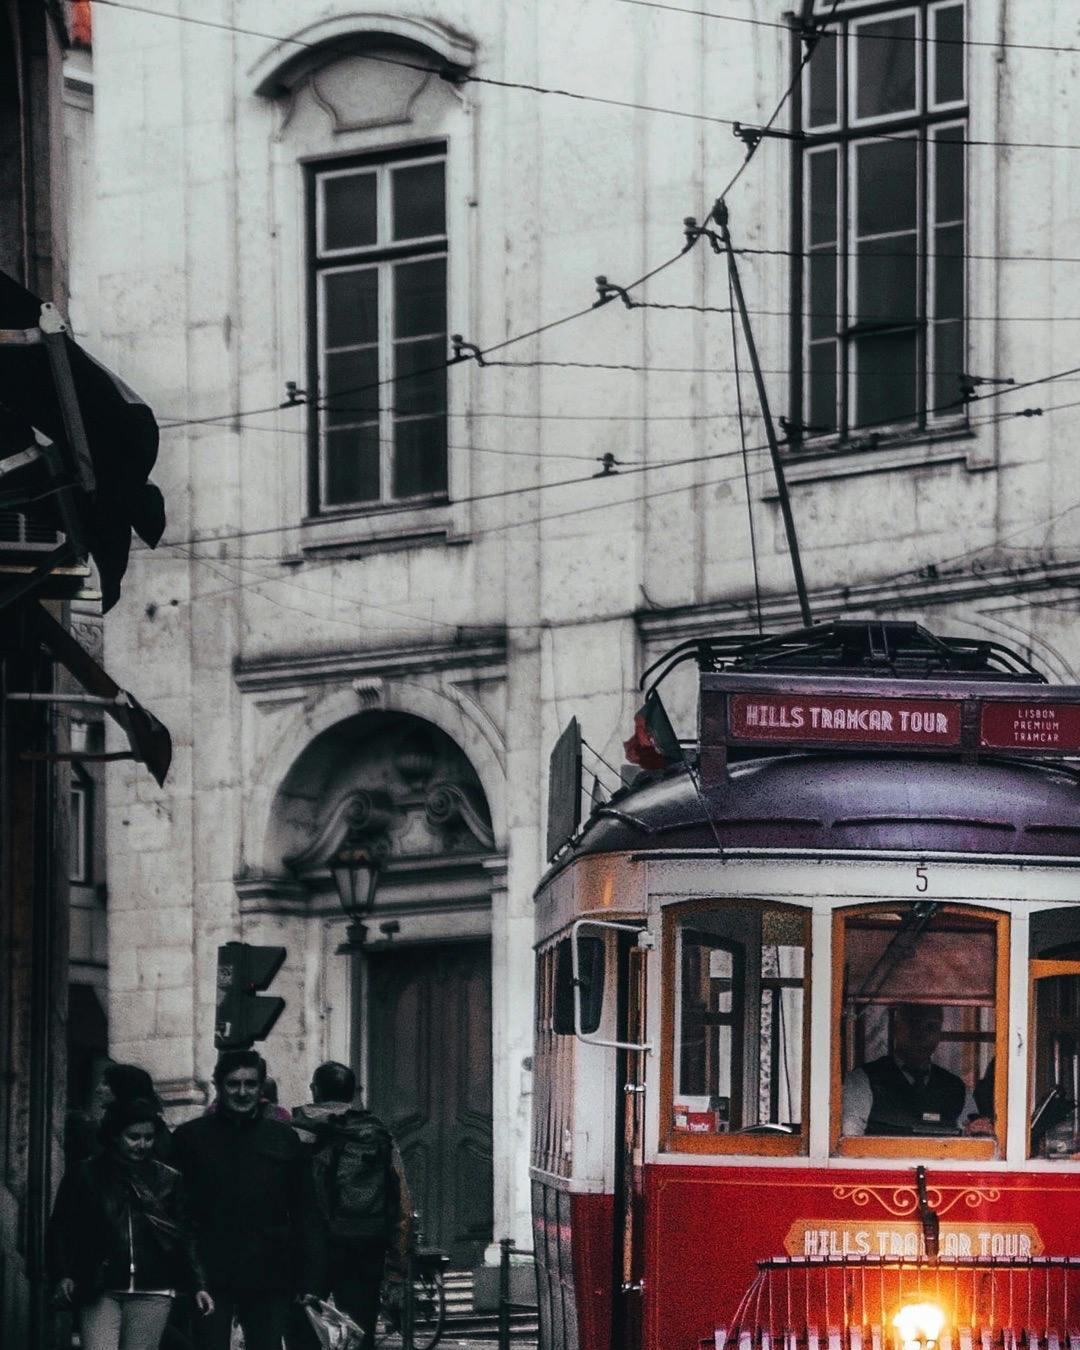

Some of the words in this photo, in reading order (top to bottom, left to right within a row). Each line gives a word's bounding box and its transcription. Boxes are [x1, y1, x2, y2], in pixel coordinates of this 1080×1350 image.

[746, 705, 804, 728] HILLS
[809, 707, 893, 731] TRAMCAR
[899, 711, 948, 733] TOUR
[1018, 709, 1055, 719] LISBON
[1013, 721, 1059, 730] PREMIUM
[1014, 732, 1059, 742] TRAMCAR
[916, 867, 928, 892] 5
[804, 1230, 870, 1256] HILLS
[978, 1232, 1031, 1257] TOUR
